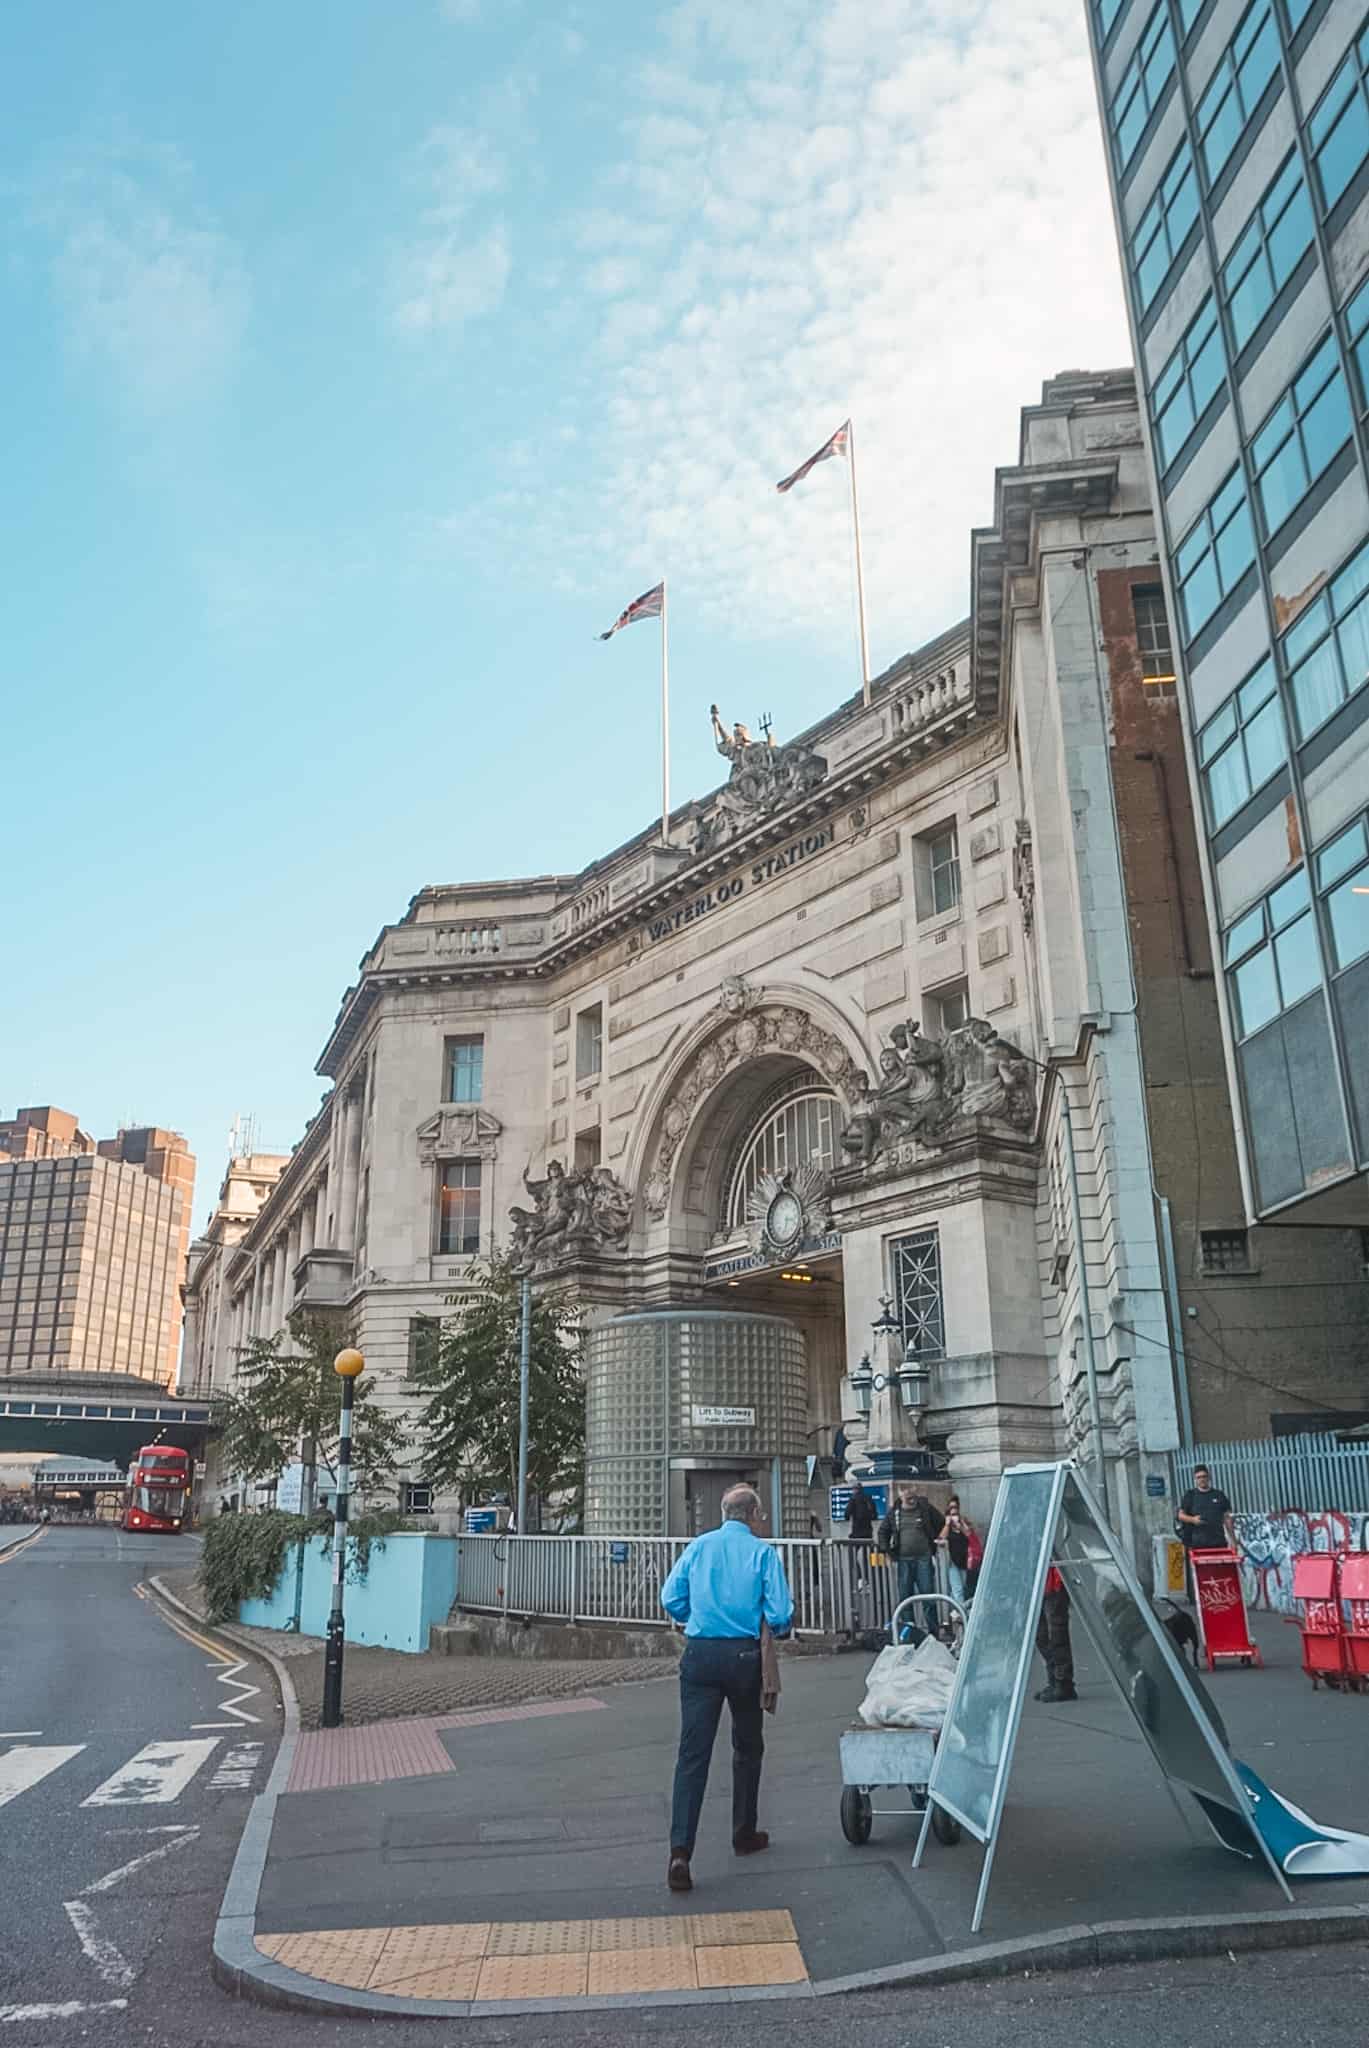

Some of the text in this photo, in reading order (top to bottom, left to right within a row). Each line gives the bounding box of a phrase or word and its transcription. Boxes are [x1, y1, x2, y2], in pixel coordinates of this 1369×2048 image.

[649, 822, 834, 942] WATERLOO STATION
[716, 1254, 765, 1275] WATERLOO
[723, 1408, 752, 1417] Subway
